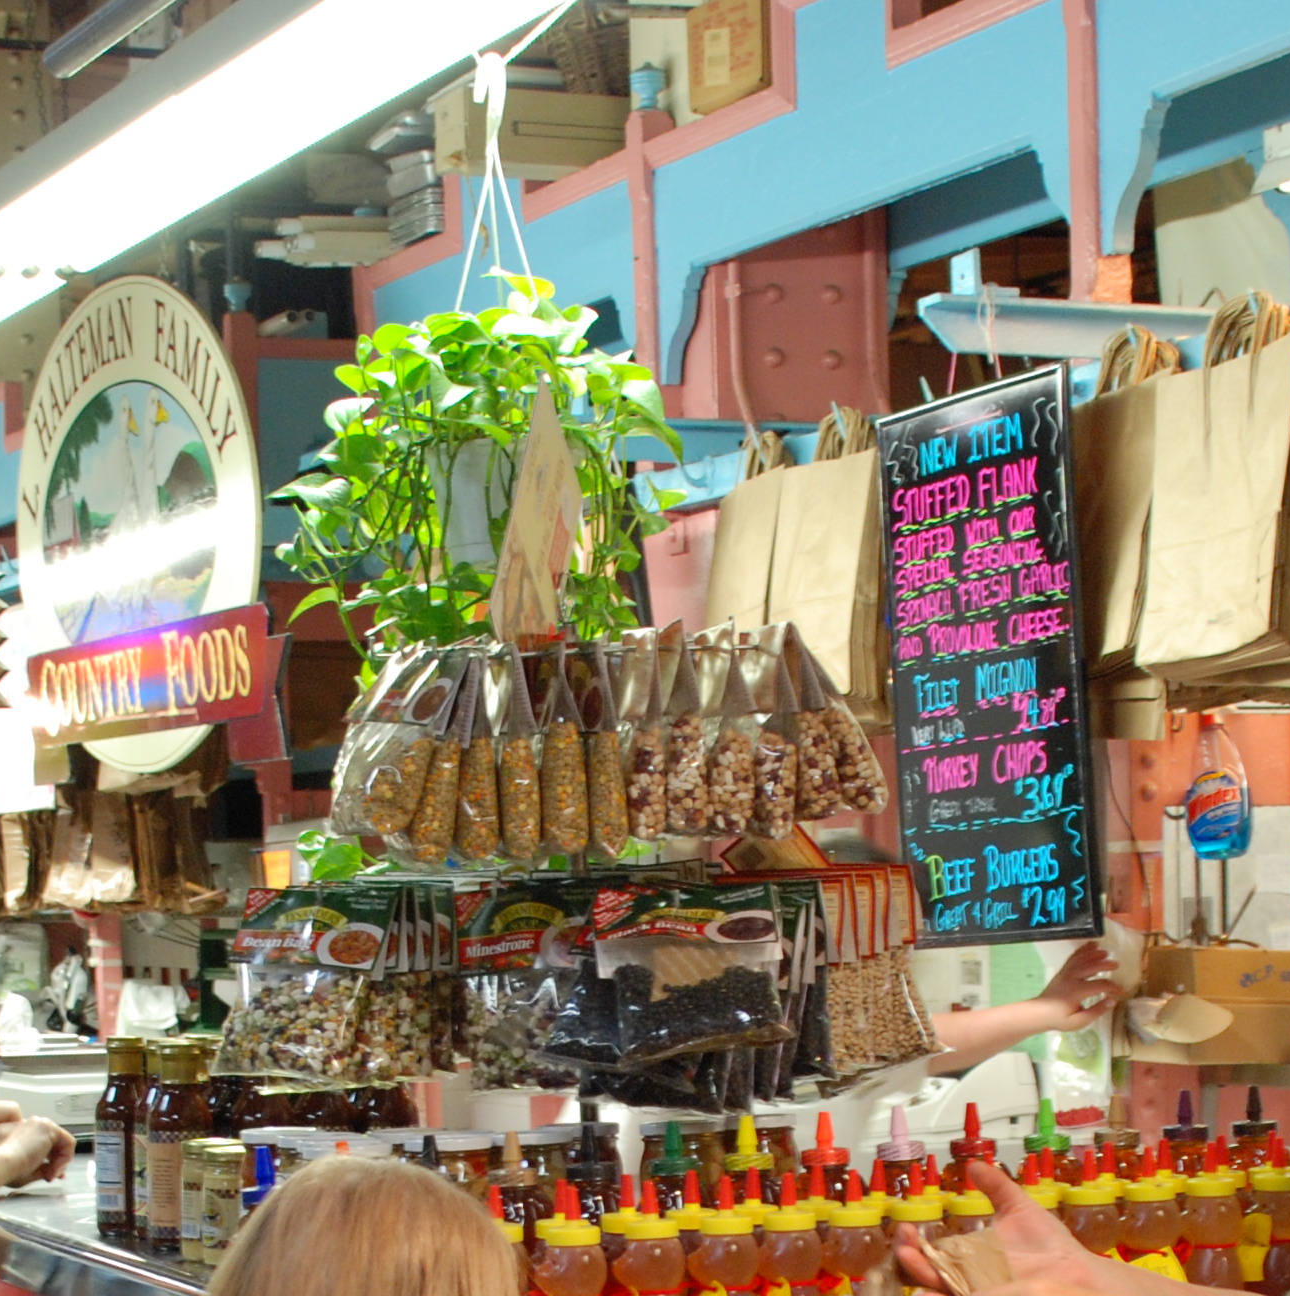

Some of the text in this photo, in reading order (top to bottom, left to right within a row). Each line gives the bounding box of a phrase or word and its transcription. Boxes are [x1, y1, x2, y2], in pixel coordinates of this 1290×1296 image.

[34, 296, 135, 462] HALTEMAN
[154, 298, 240, 464] FAMILY
[919, 412, 1024, 477] NEW ITEM
[892, 456, 1039, 533] STUFFED FLANK
[894, 506, 1036, 566] STUFFED WITH OUR
[895, 558, 956, 599] SPECIAL
[959, 575, 1012, 613] FRESH
[898, 636, 923, 660] AND
[38, 624, 252, 739] COUNTRY FOODS
[912, 656, 1038, 714] FILET MIGNON
[921, 740, 1049, 794] TURKEY CHOPS
[925, 854, 977, 902] BEEF
[982, 843, 1060, 894] BURGERS
[241, 936, 283, 949] Bean
[465, 938, 535, 959] Minestrone
[654, 920, 698, 934] Bean
